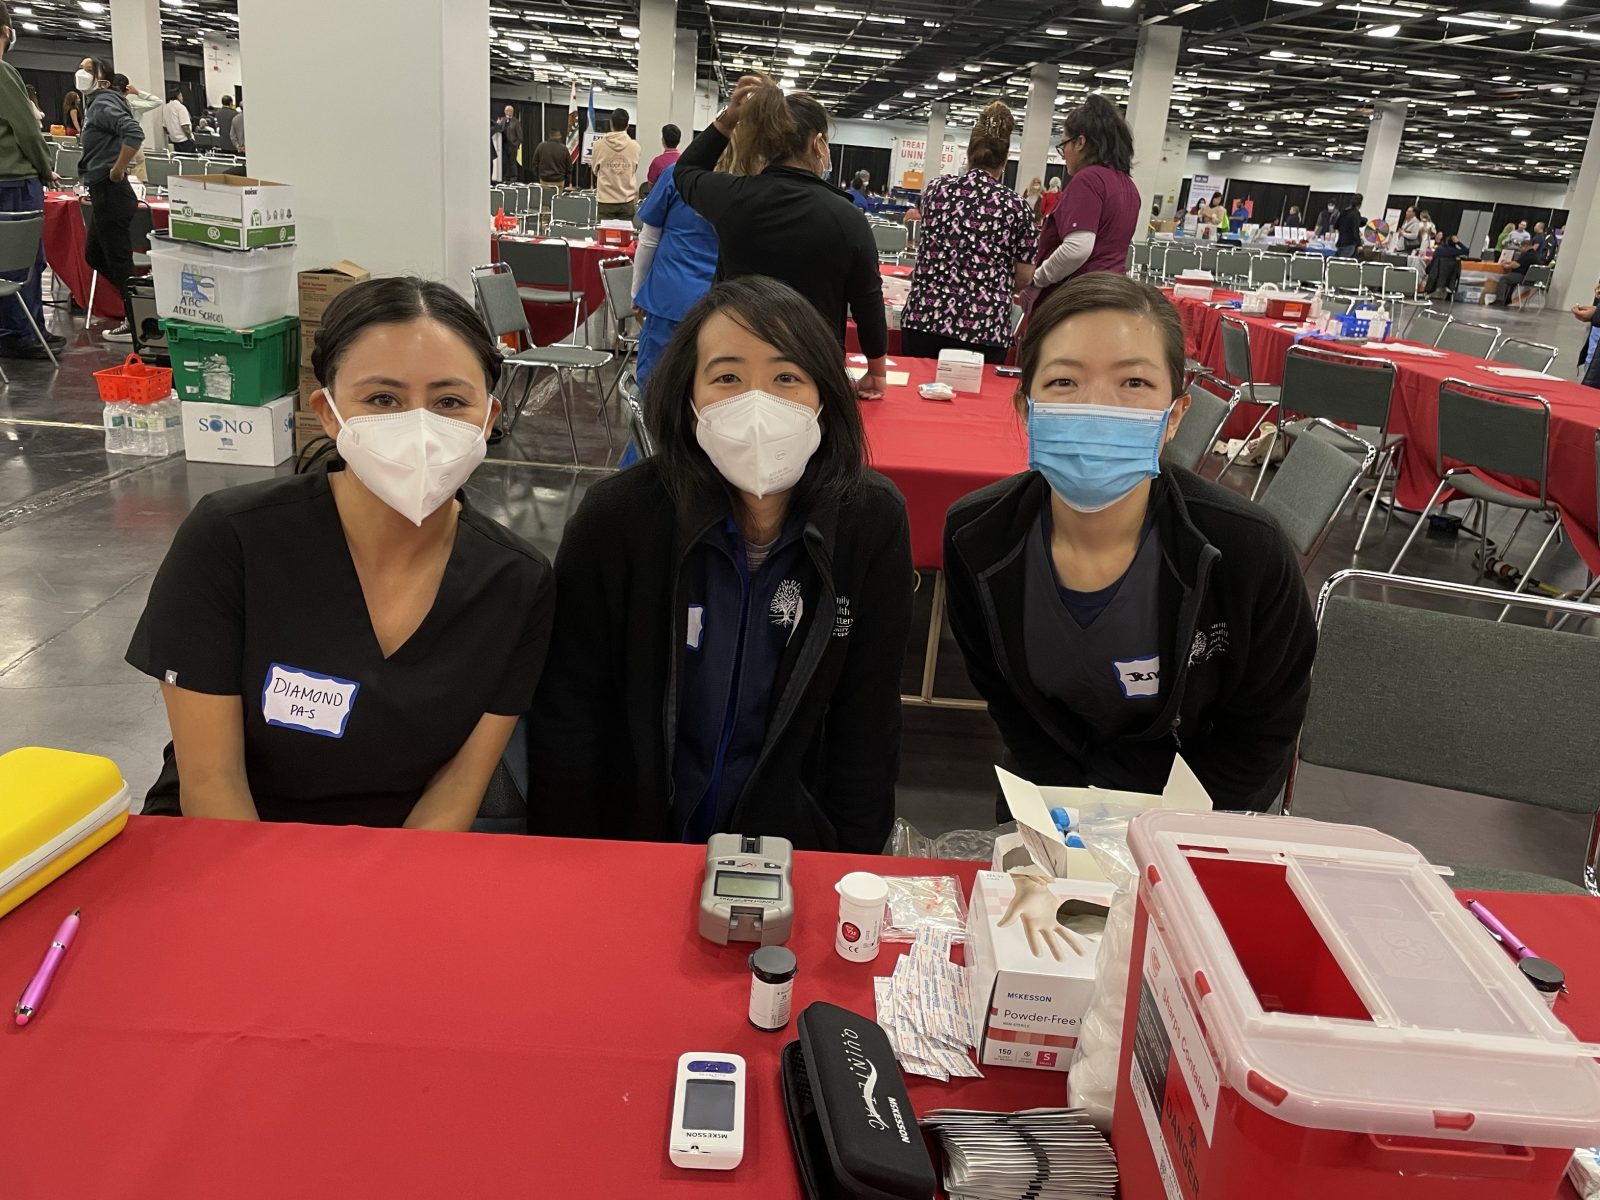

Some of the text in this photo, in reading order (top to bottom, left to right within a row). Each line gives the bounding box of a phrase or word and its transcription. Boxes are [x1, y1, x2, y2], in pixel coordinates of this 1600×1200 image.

[902, 141, 925, 149] TREAT
[180, 296, 203, 308] ABC
[173, 305, 224, 323] ADULT SCHOOL
[273, 677, 343, 707] DIAMOND
[290, 704, 315, 719] PA-S
[1003, 1009, 1076, 1026] Powder-Free
[998, 1048, 1012, 1056] 150
[1043, 1053, 1051, 1061] S
[1162, 987, 1210, 1111] Sharps Container
[1166, 1095, 1200, 1200] DANGER
